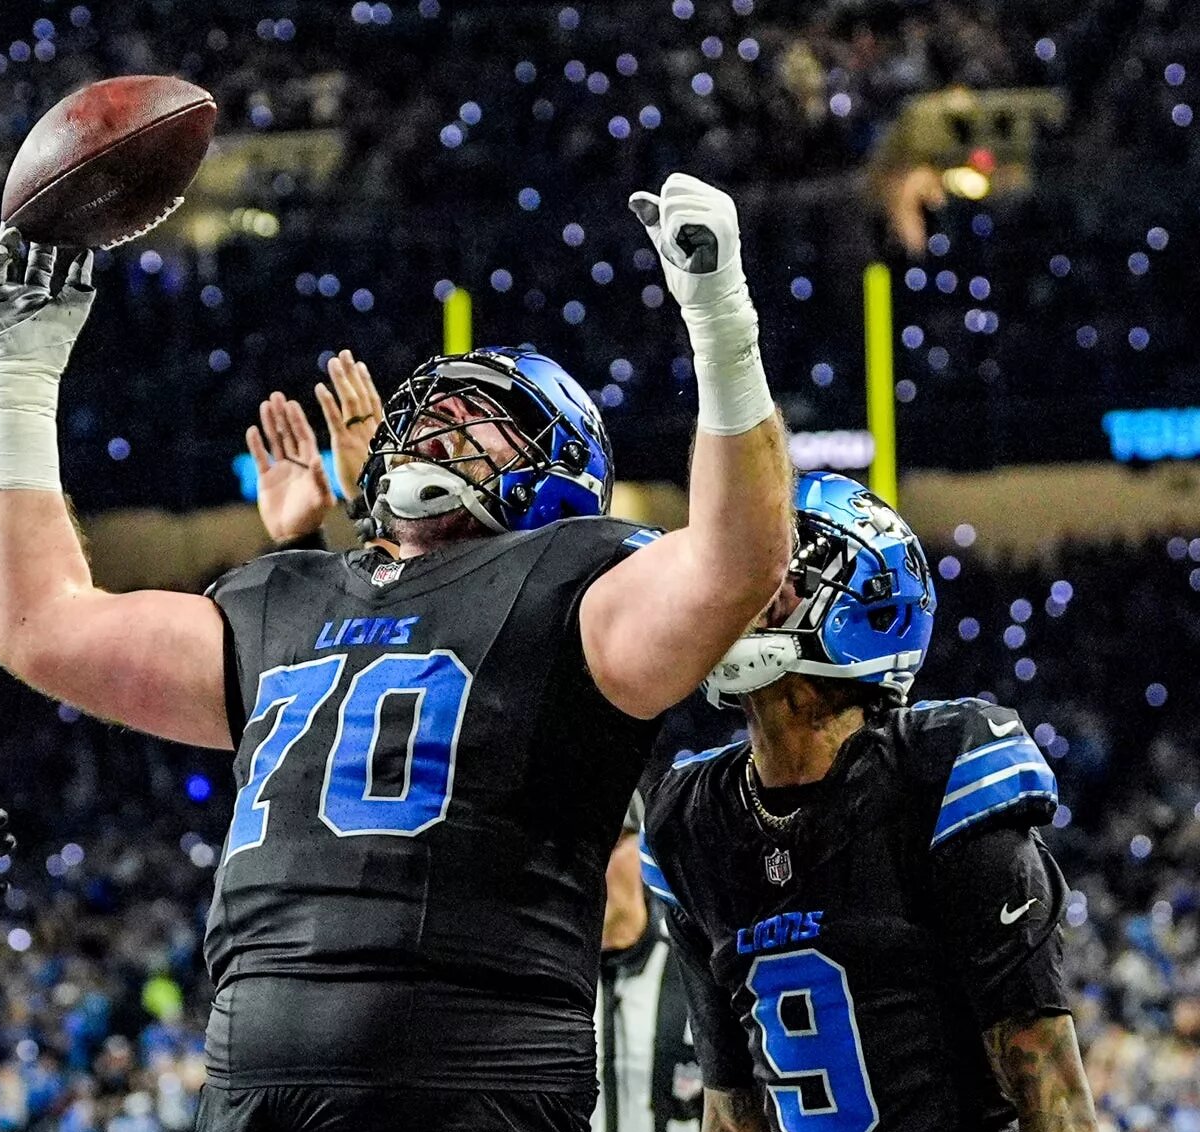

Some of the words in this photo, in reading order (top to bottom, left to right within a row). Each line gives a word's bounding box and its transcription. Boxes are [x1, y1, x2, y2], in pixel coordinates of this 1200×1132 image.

[314, 616, 421, 650] LIONS
[222, 649, 474, 866] 70
[736, 911, 824, 954] LIONS
